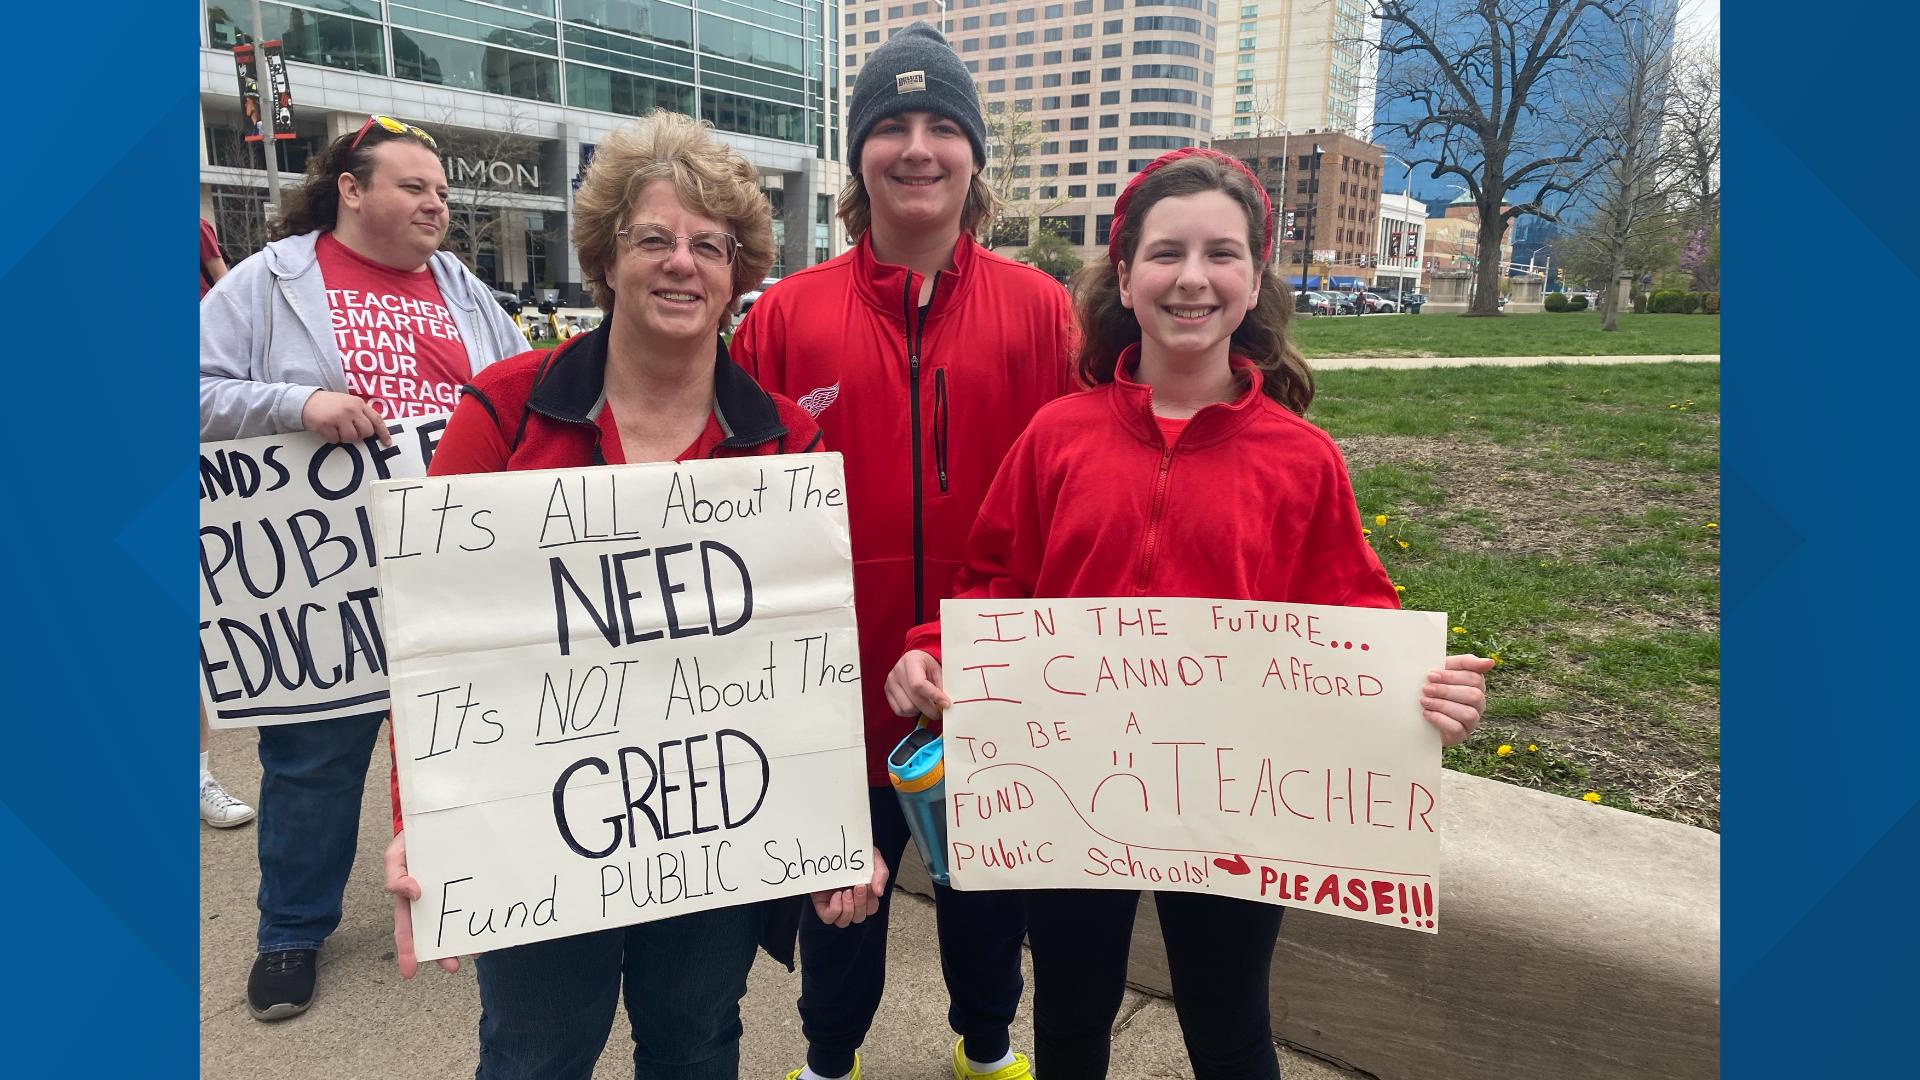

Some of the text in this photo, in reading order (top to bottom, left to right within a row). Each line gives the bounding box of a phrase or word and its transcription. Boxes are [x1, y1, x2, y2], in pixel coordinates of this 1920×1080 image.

[447, 156, 540, 189] IMON
[330, 308, 462, 343] SMARTER
[334, 329, 416, 354] THAN
[339, 349, 419, 377] YOUR
[366, 397, 455, 420] OVER
[200, 445, 291, 502] NDS
[384, 464, 844, 560] Its ALL About The
[549, 540, 754, 656] NEED
[973, 607, 1056, 645] IN
[1086, 606, 1169, 637] THE
[414, 632, 861, 761] Its NOT About The
[953, 663, 1022, 704] I
[1043, 654, 1228, 697] CANNOT
[955, 710, 1143, 764] TO BE A
[552, 728, 770, 860] GREED
[953, 780, 1034, 828] FUND
[1151, 741, 1436, 833] TEACHER
[437, 825, 866, 948] Fund PUBLIC Schools
[1259, 865, 1435, 930] PLEASE!!!
